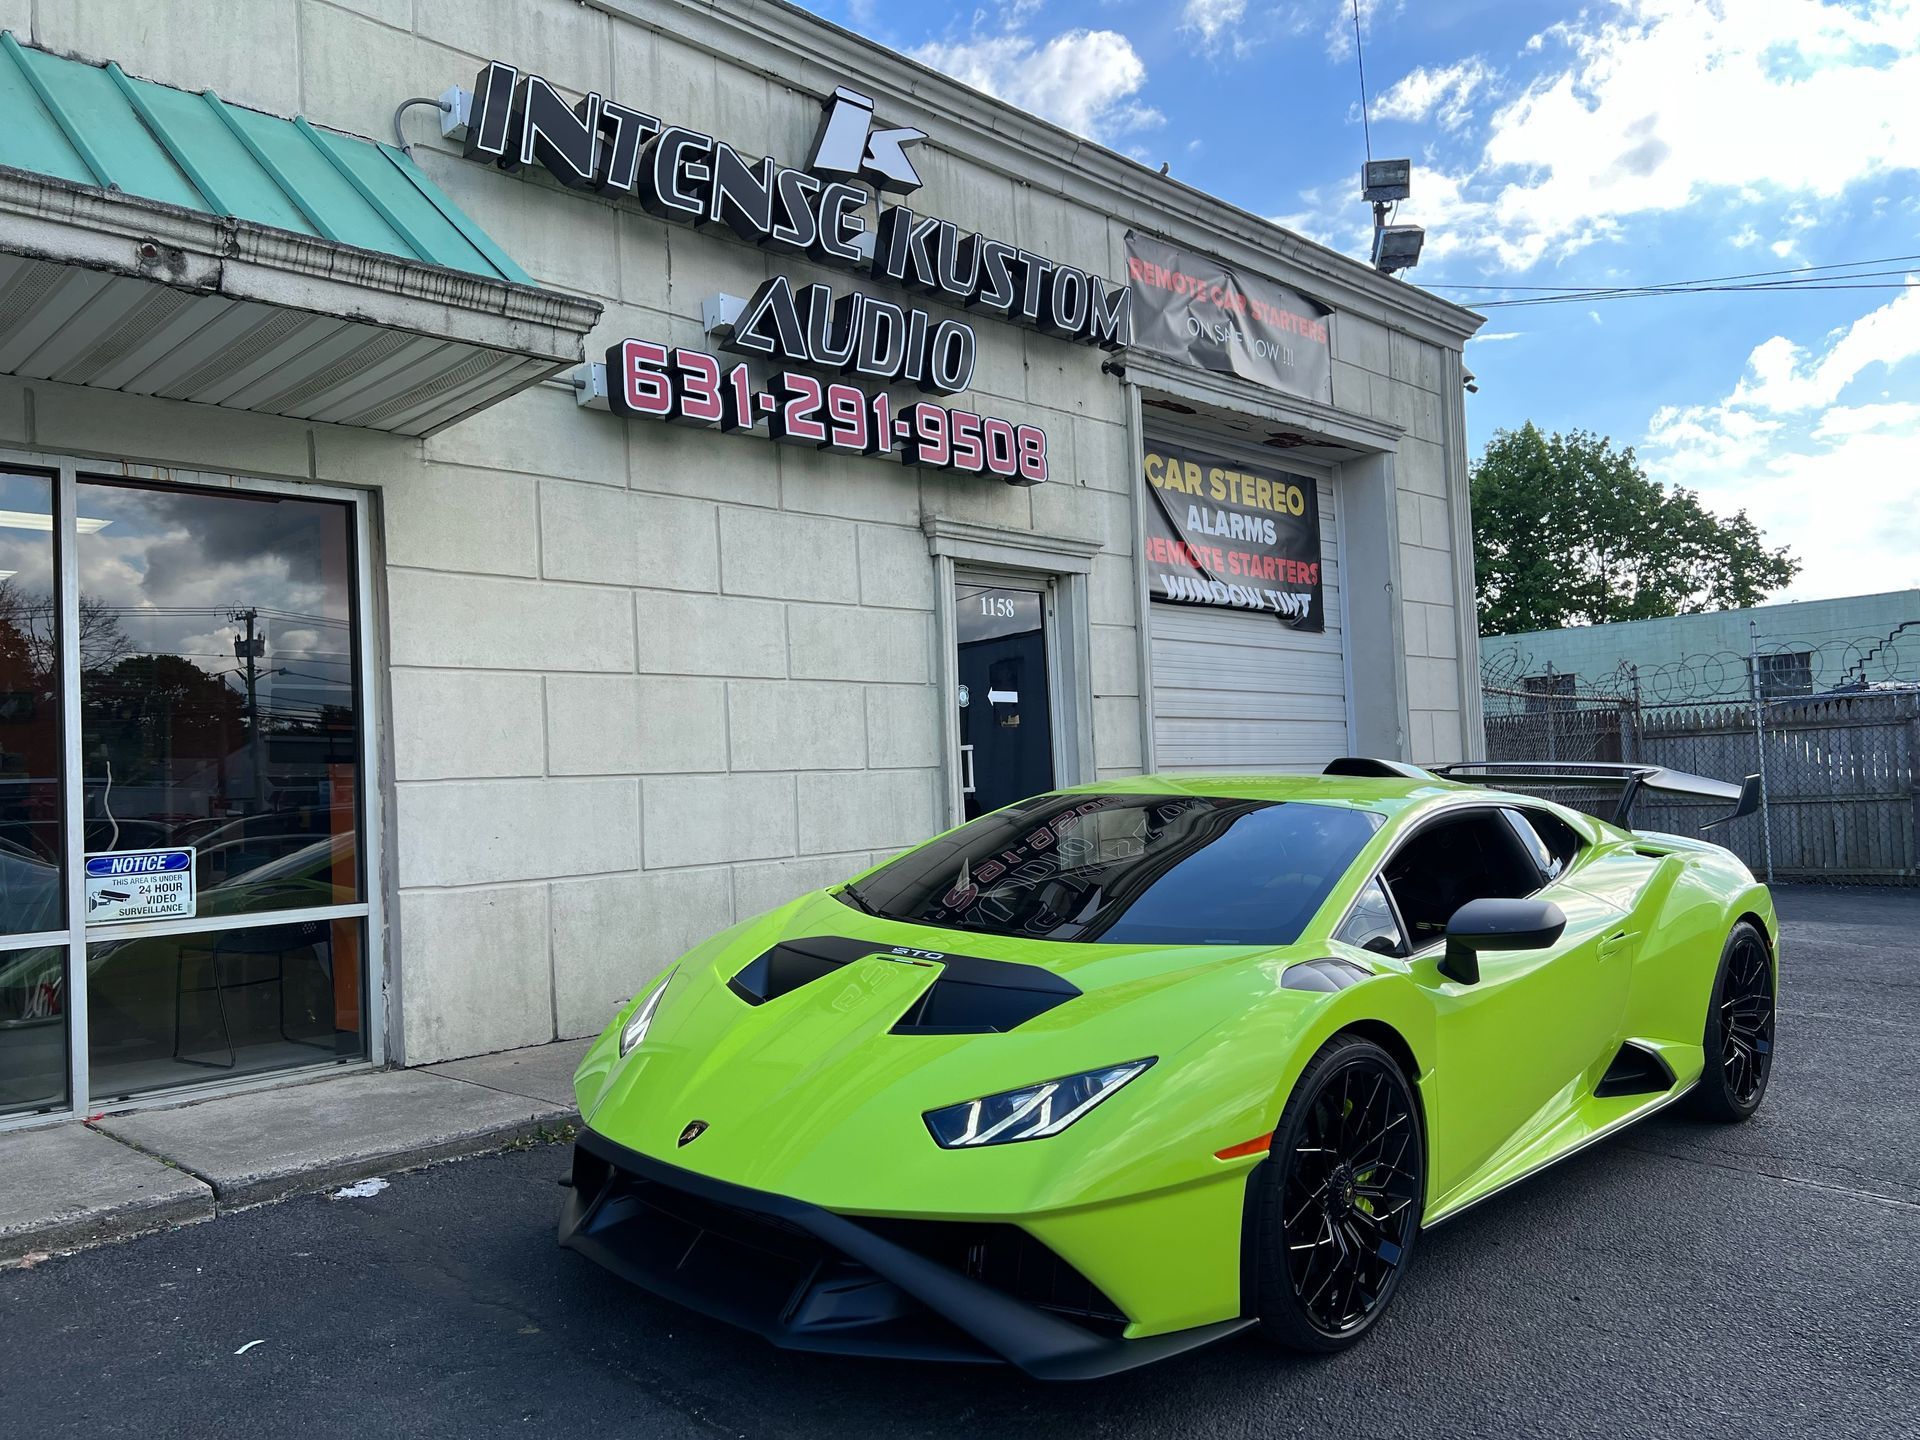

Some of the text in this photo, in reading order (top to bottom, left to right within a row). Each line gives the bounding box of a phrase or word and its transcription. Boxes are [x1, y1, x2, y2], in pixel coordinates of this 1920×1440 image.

[474, 60, 1132, 350] INTENSE KUSTOM
[1128, 256, 1327, 344] REMOTE CAR STARTERS
[734, 275, 977, 396] AUDIO
[1187, 317, 1218, 345] ON
[620, 338, 1049, 485] 631-291-9508
[1144, 453, 1305, 517] CAR STEREO
[1186, 504, 1278, 546] ALARMS
[1146, 536, 1319, 587] REMOTE STARTERS
[980, 597, 1015, 618] 1158
[1160, 573, 1312, 618] WINDOW TINT
[111, 855, 167, 874] NOTICE
[112, 874, 183, 886] THIS AREA IS UNDER
[139, 882, 183, 895] 24 HOUR
[146, 893, 177, 905] VIDEO
[119, 903, 183, 917] SURVEILLANCE
[891, 947, 944, 960] STO
